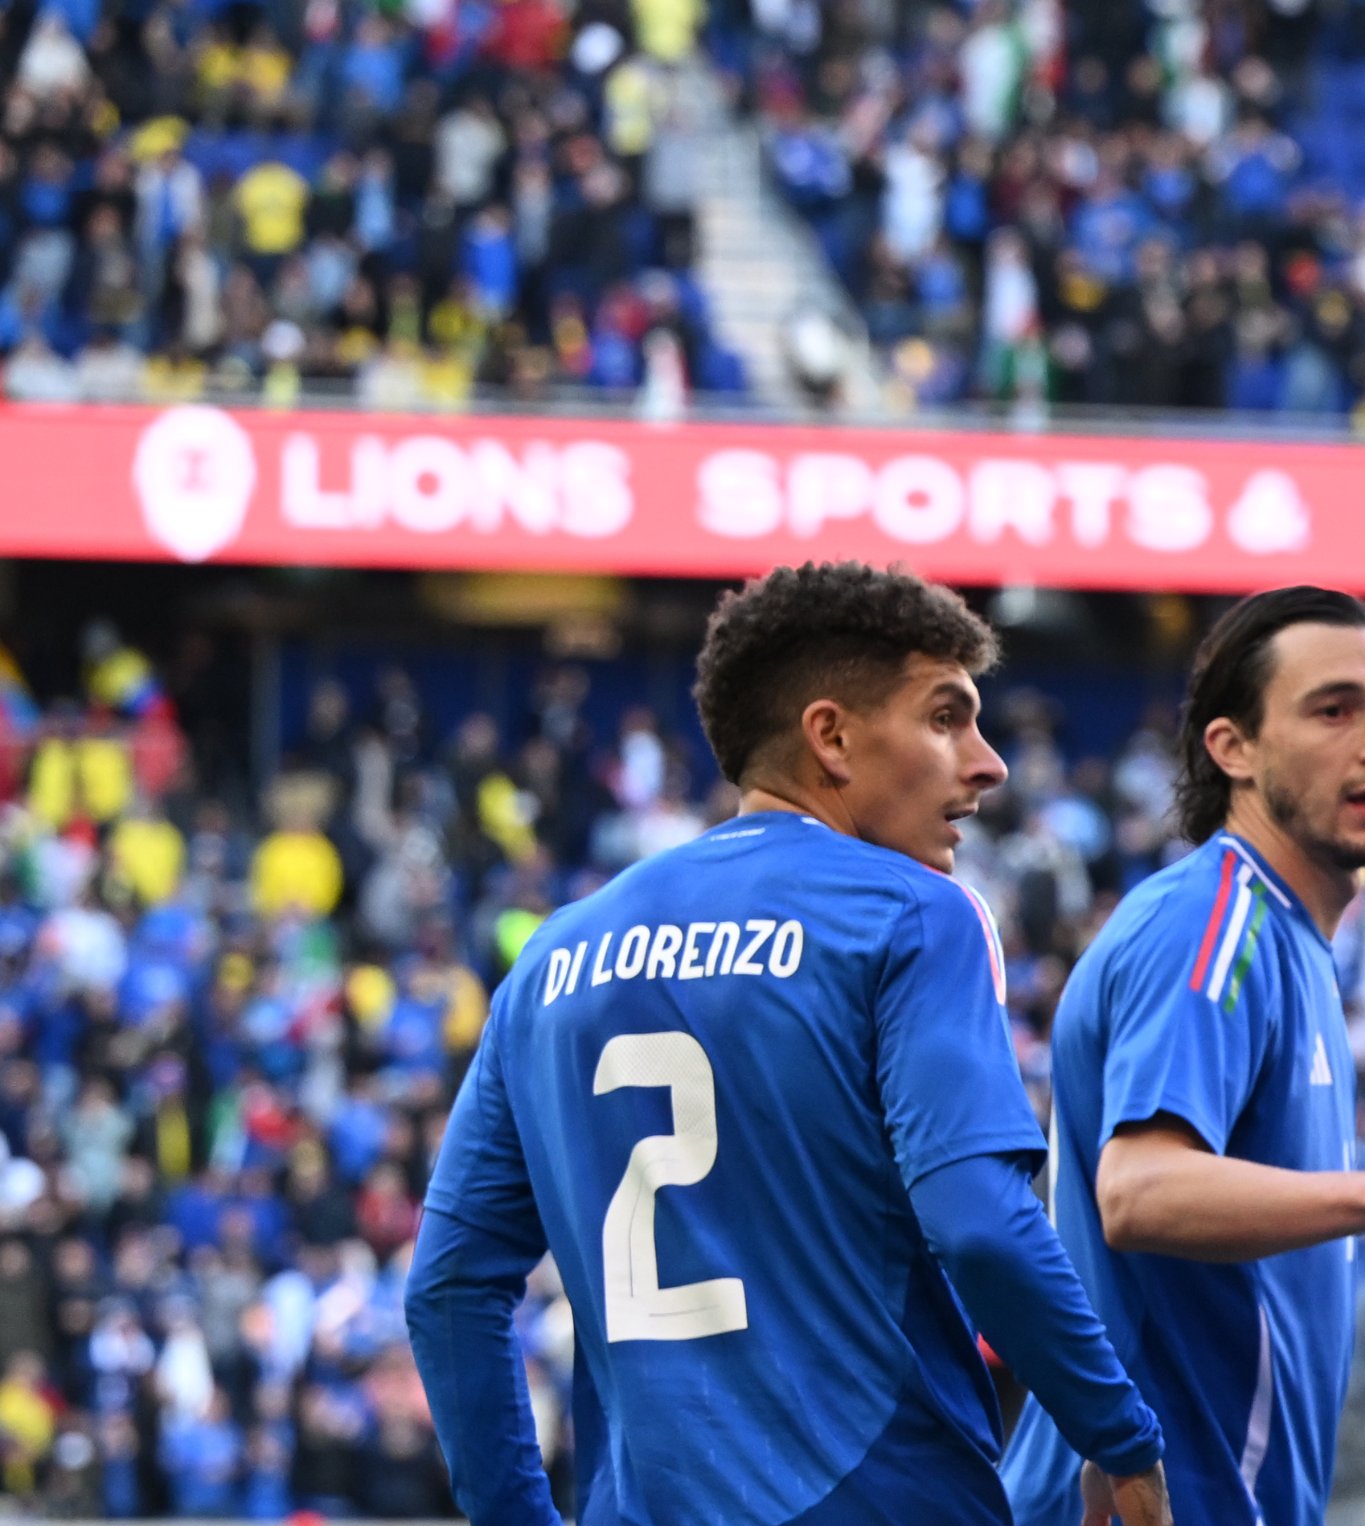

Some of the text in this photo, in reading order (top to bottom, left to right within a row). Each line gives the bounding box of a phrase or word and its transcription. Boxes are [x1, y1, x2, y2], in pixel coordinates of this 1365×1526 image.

[280, 430, 634, 538] LIONS
[696, 446, 1212, 552] SPORTS
[543, 918, 804, 1007] DI LORENZO
[593, 1030, 749, 1343] 2
